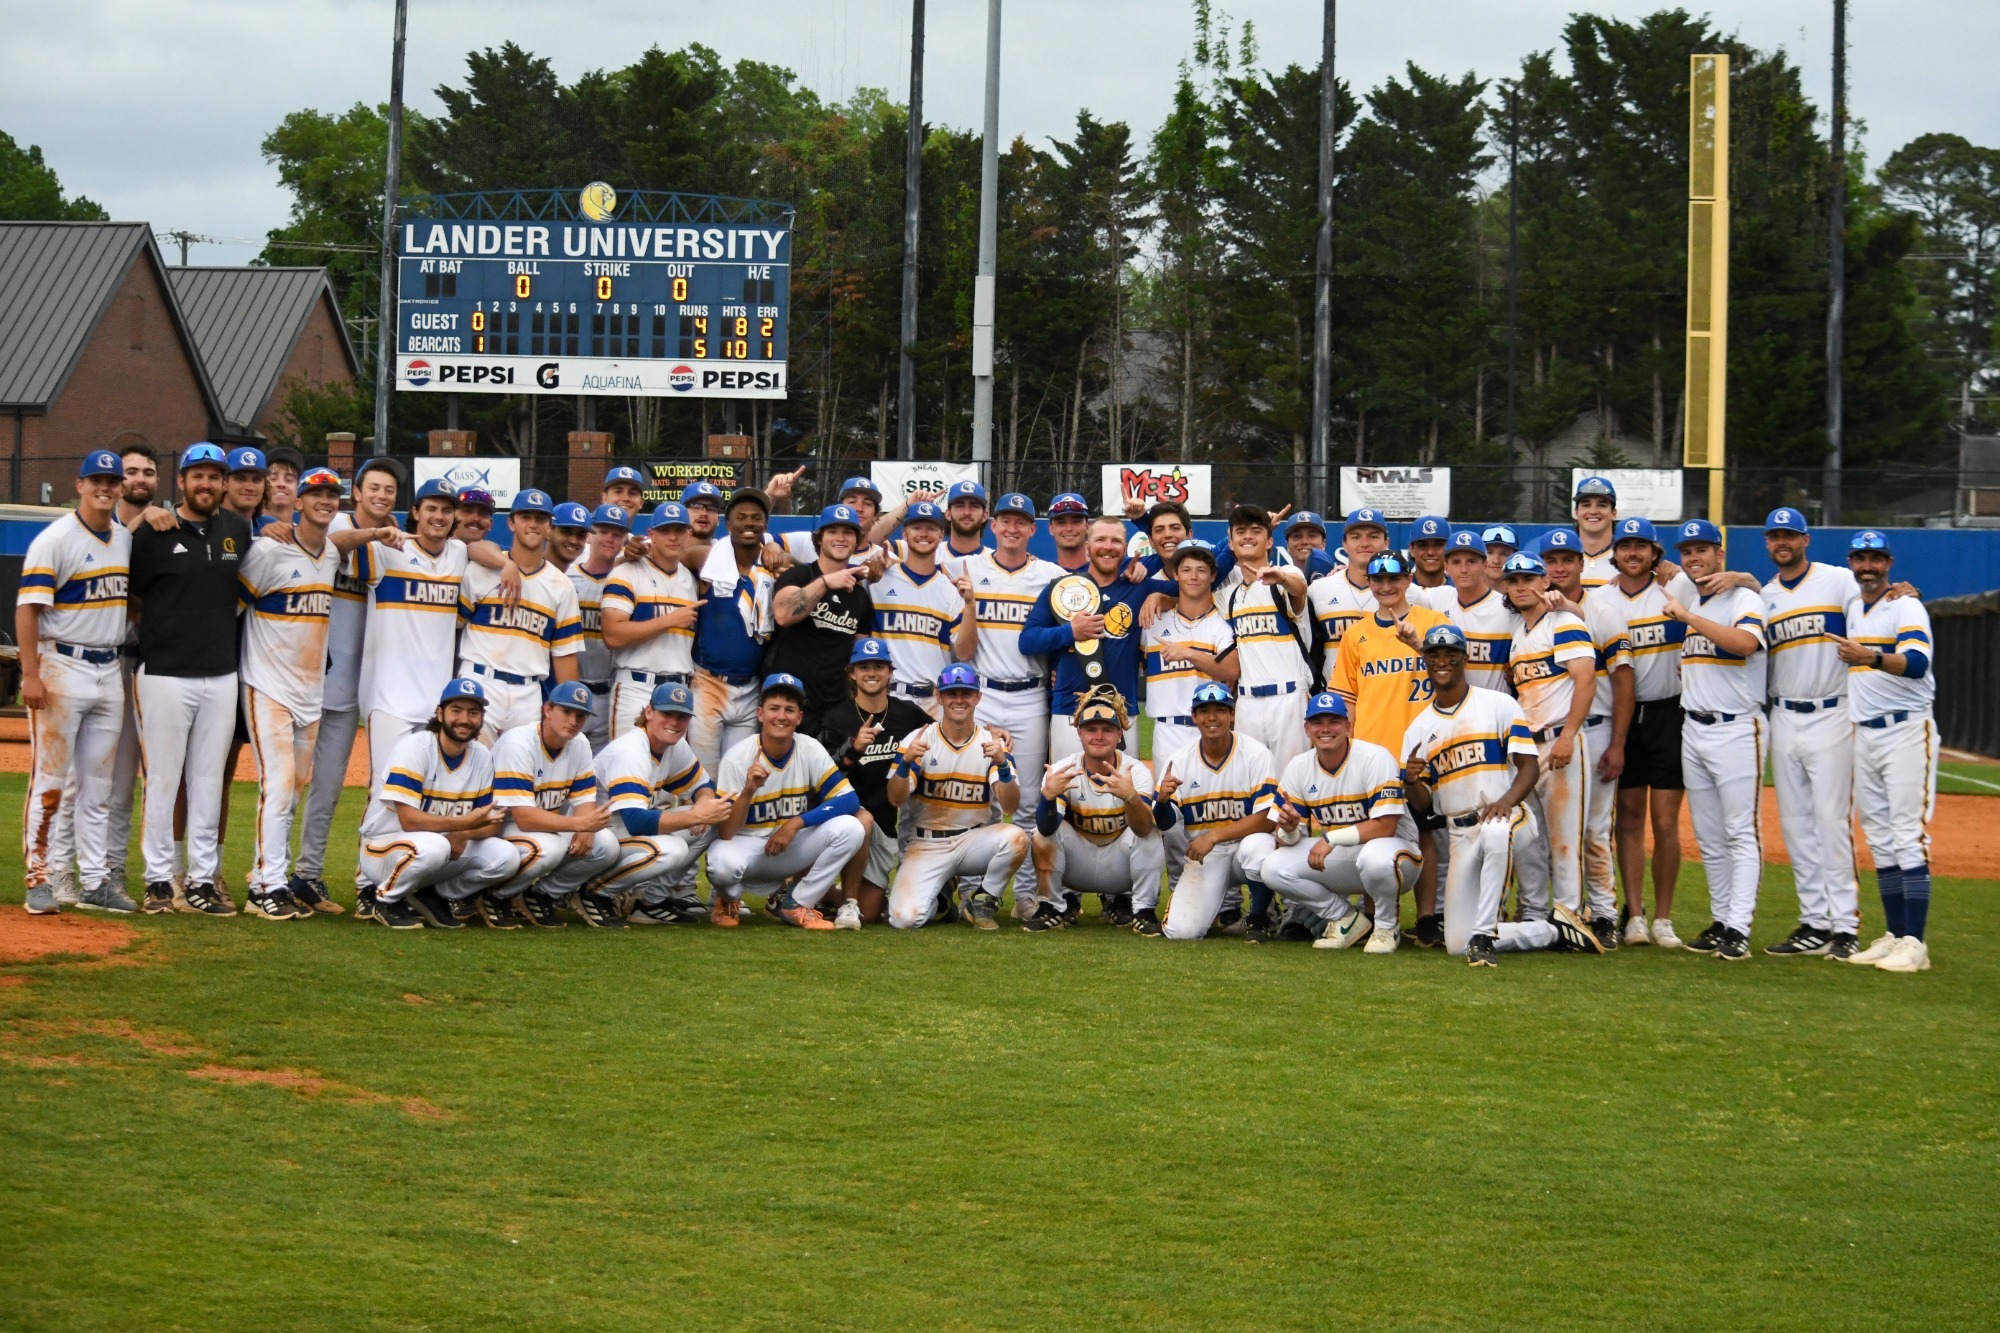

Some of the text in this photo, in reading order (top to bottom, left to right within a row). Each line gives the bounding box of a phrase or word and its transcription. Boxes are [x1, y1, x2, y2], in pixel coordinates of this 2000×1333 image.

[405, 223, 786, 260] LANDER UNIVERSITY
[420, 259, 463, 274] AT BAT
[508, 261, 540, 275] BALL
[584, 262, 631, 277] STRIKE
[667, 264, 695, 278] OUT
[748, 265, 770, 281] H/E
[516, 275, 531, 299] 0
[597, 276, 612, 300] 0
[672, 278, 688, 302] 0
[476, 301, 778, 318] 1 2 3 4 5 6 7 8 9 10 RUNS HITS ERR
[411, 312, 459, 330] GUEST
[472, 312, 774, 337] 0 4 8 2
[408, 335, 461, 353] BEARCATS
[477, 336, 773, 359] 1 5 10 1
[407, 369, 432, 377] PEPSI
[439, 364, 514, 385] PEPSI
[582, 374, 643, 391] AQUAFINA
[670, 374, 695, 382] PEPSI
[702, 370, 780, 390] PEPSI
[454, 471, 475, 481] BASS
[653, 465, 734, 478] WORKBOOTS
[912, 463, 938, 473] SNEAD
[1356, 467, 1434, 484] RIVALS
[651, 479, 671, 487] HATS
[905, 479, 945, 494] SBS
[642, 489, 684, 501] CULTUR
[85, 575, 128, 601] LANDE
[405, 580, 459, 605] LANDER
[285, 593, 331, 615] LANDE
[976, 600, 1034, 623] LANDE
[489, 605, 549, 637] LANDER
[810, 602, 859, 629] Lander
[883, 611, 942, 637] LANDER
[1768, 614, 1826, 645] LANDER
[1360, 656, 1427, 677] ANDER
[1407, 678, 1434, 702] 29
[865, 735, 899, 756] ande
[1074, 813, 1127, 834] LANDE
